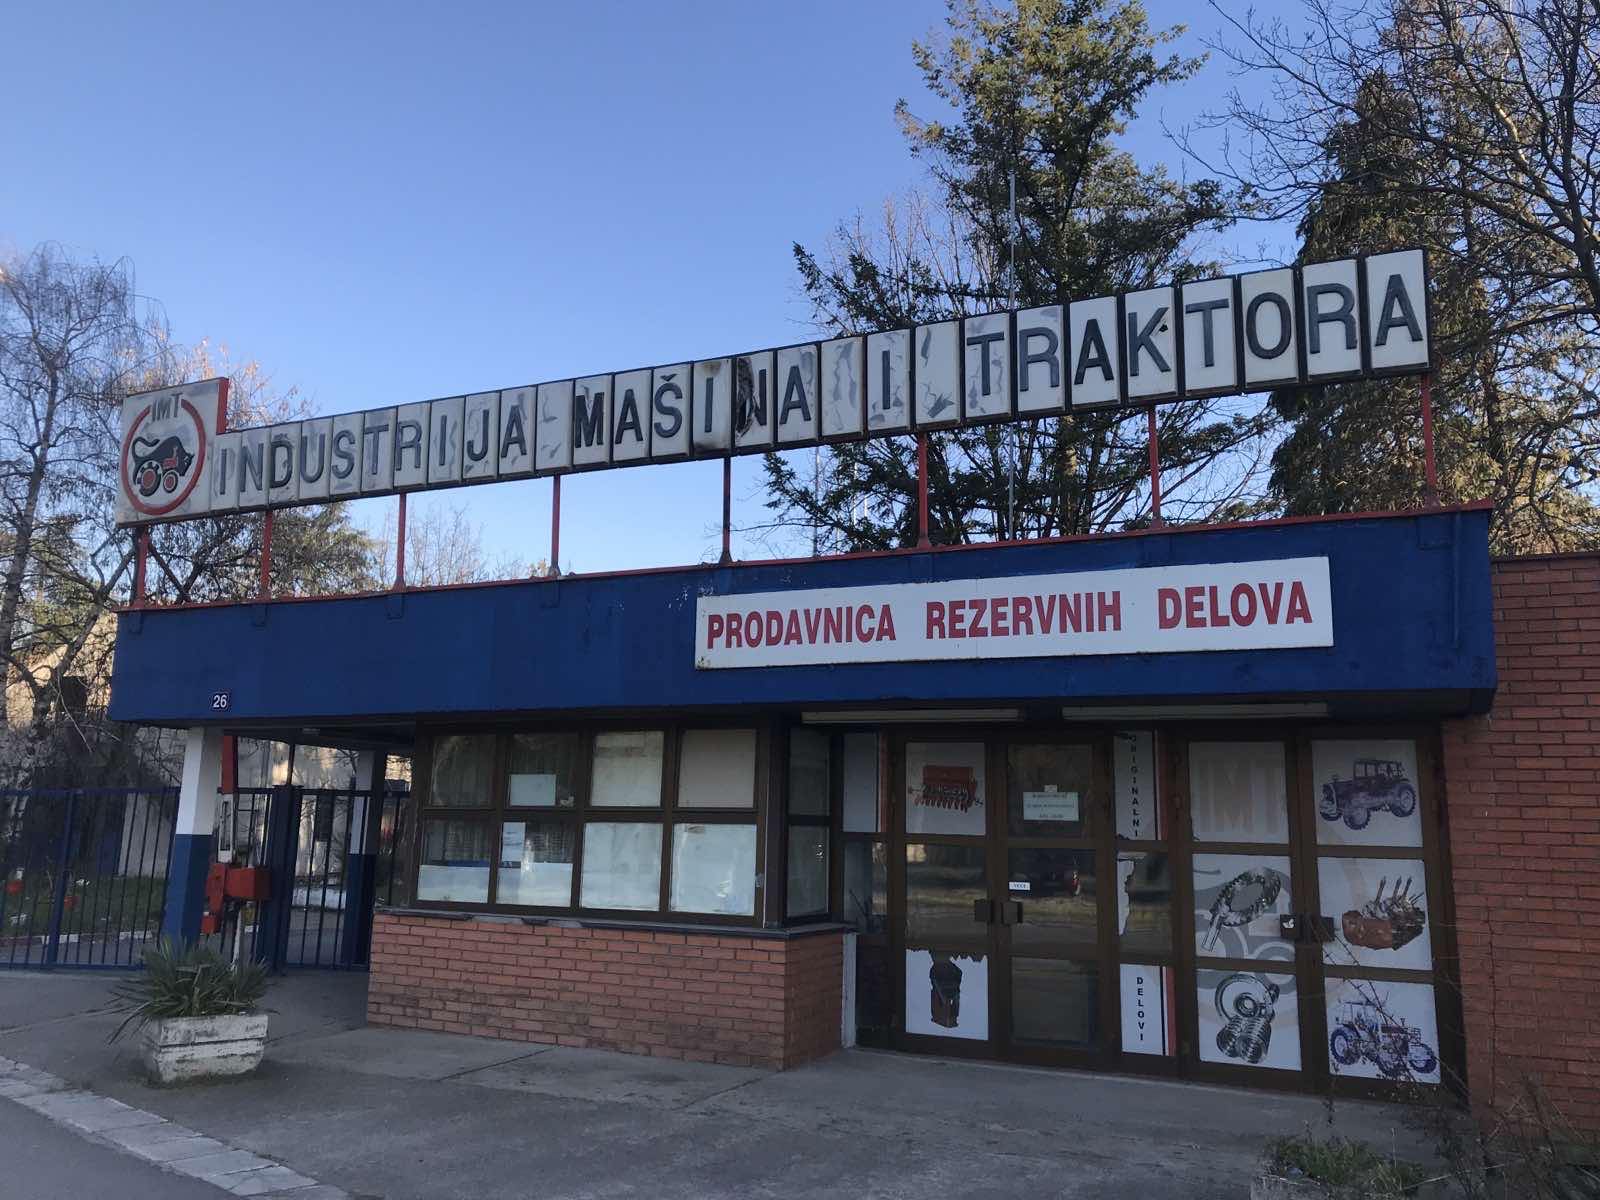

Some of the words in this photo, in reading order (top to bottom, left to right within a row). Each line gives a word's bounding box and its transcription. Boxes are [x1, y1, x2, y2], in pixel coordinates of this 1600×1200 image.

[151, 393, 182, 422] IMT
[218, 405, 529, 496] INDUSTRIJA
[574, 373, 812, 449] MAŠINA
[880, 350, 892, 411] I
[966, 273, 1424, 396] TRAKTORA
[706, 603, 896, 649] PRODAVNICA
[925, 591, 1122, 639] REZERVNIH
[1158, 580, 1313, 630] DELOVA
[213, 694, 228, 708] 26
[1136, 976, 1145, 1041] DELOVI
